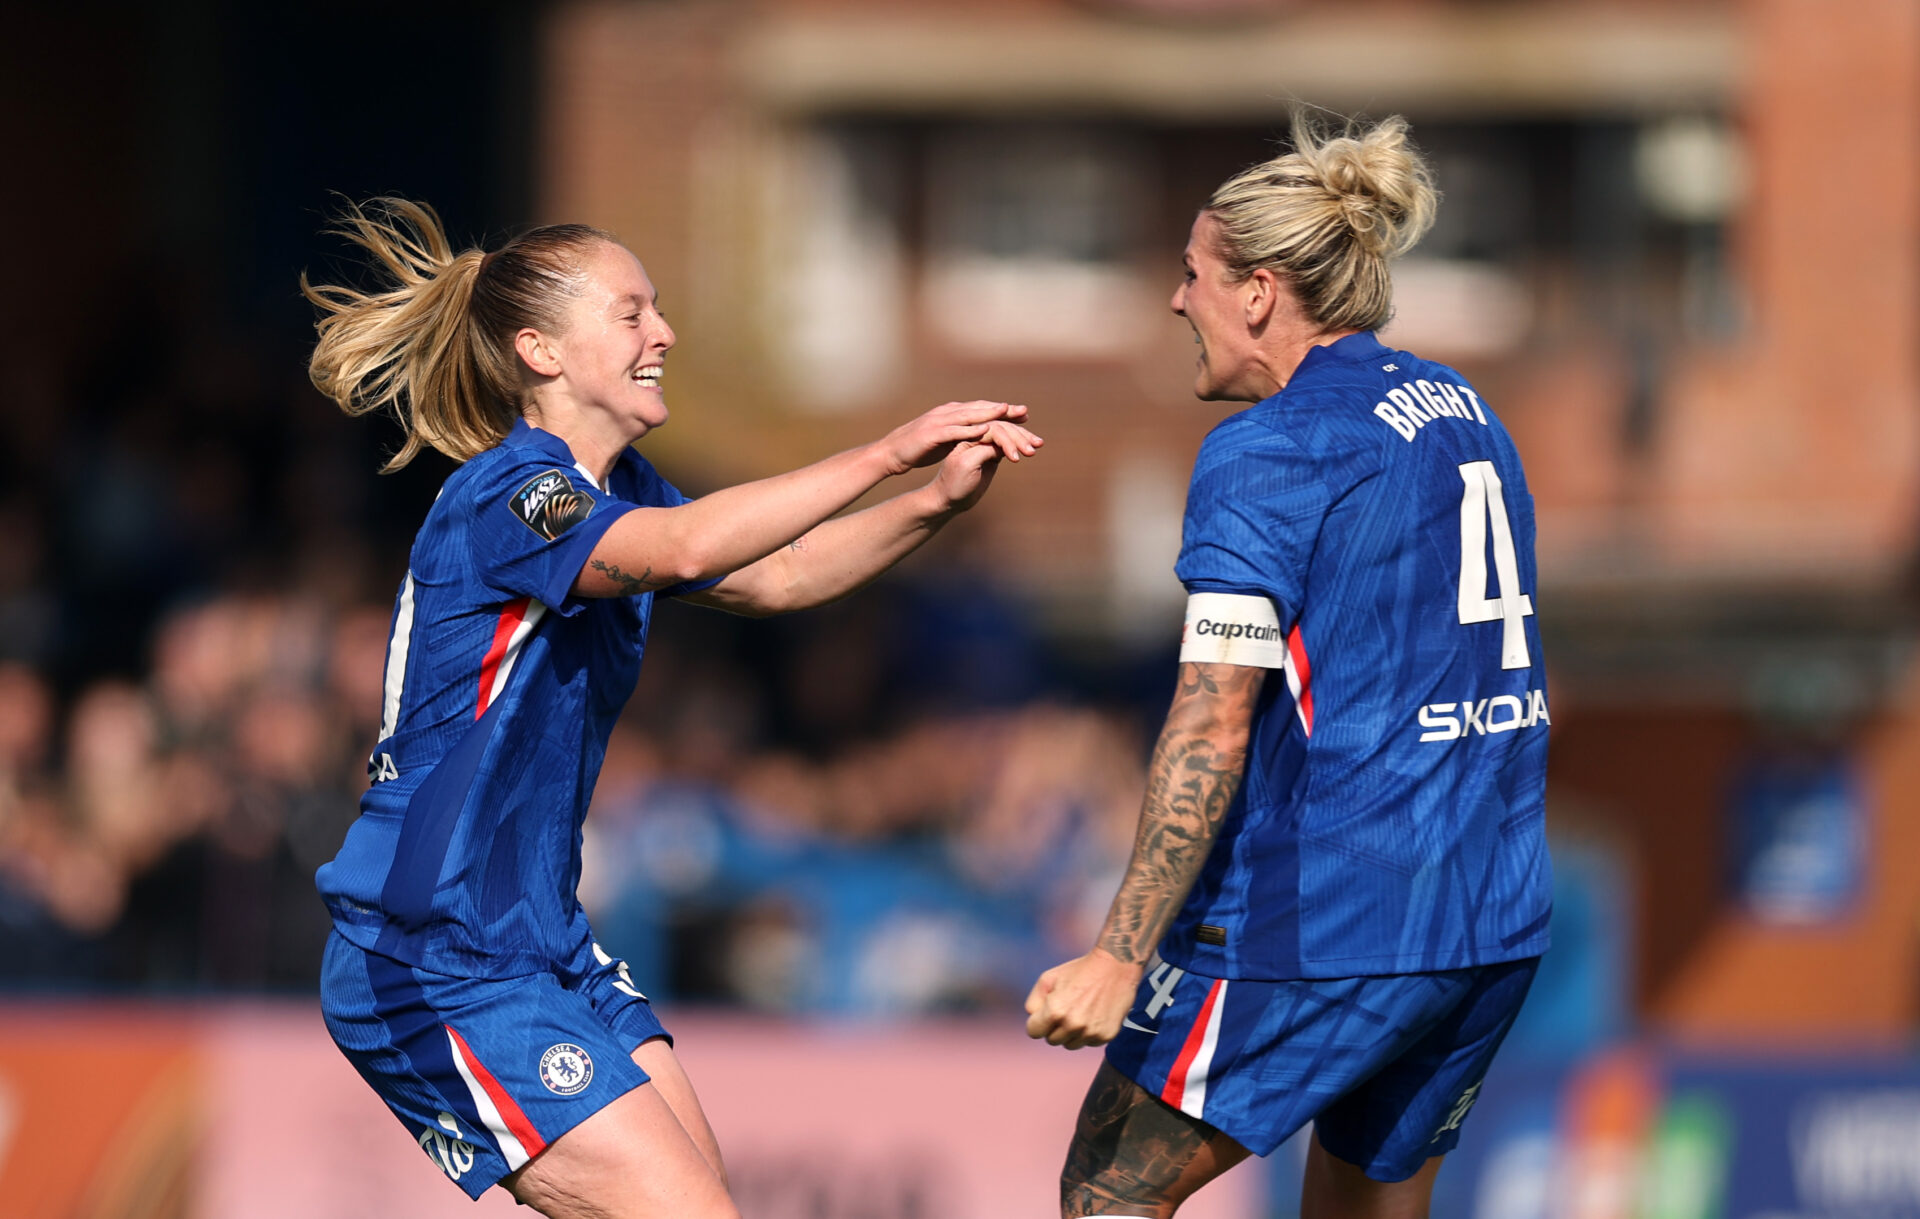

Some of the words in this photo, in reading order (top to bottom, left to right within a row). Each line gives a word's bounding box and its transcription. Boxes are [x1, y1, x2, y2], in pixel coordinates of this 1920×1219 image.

[1373, 379, 1489, 443] BRIGHT
[1457, 459, 1534, 670] 4
[1196, 618, 1279, 642] Captain
[1144, 961, 1186, 1020] 4
[542, 1045, 571, 1067] CHELSEA
